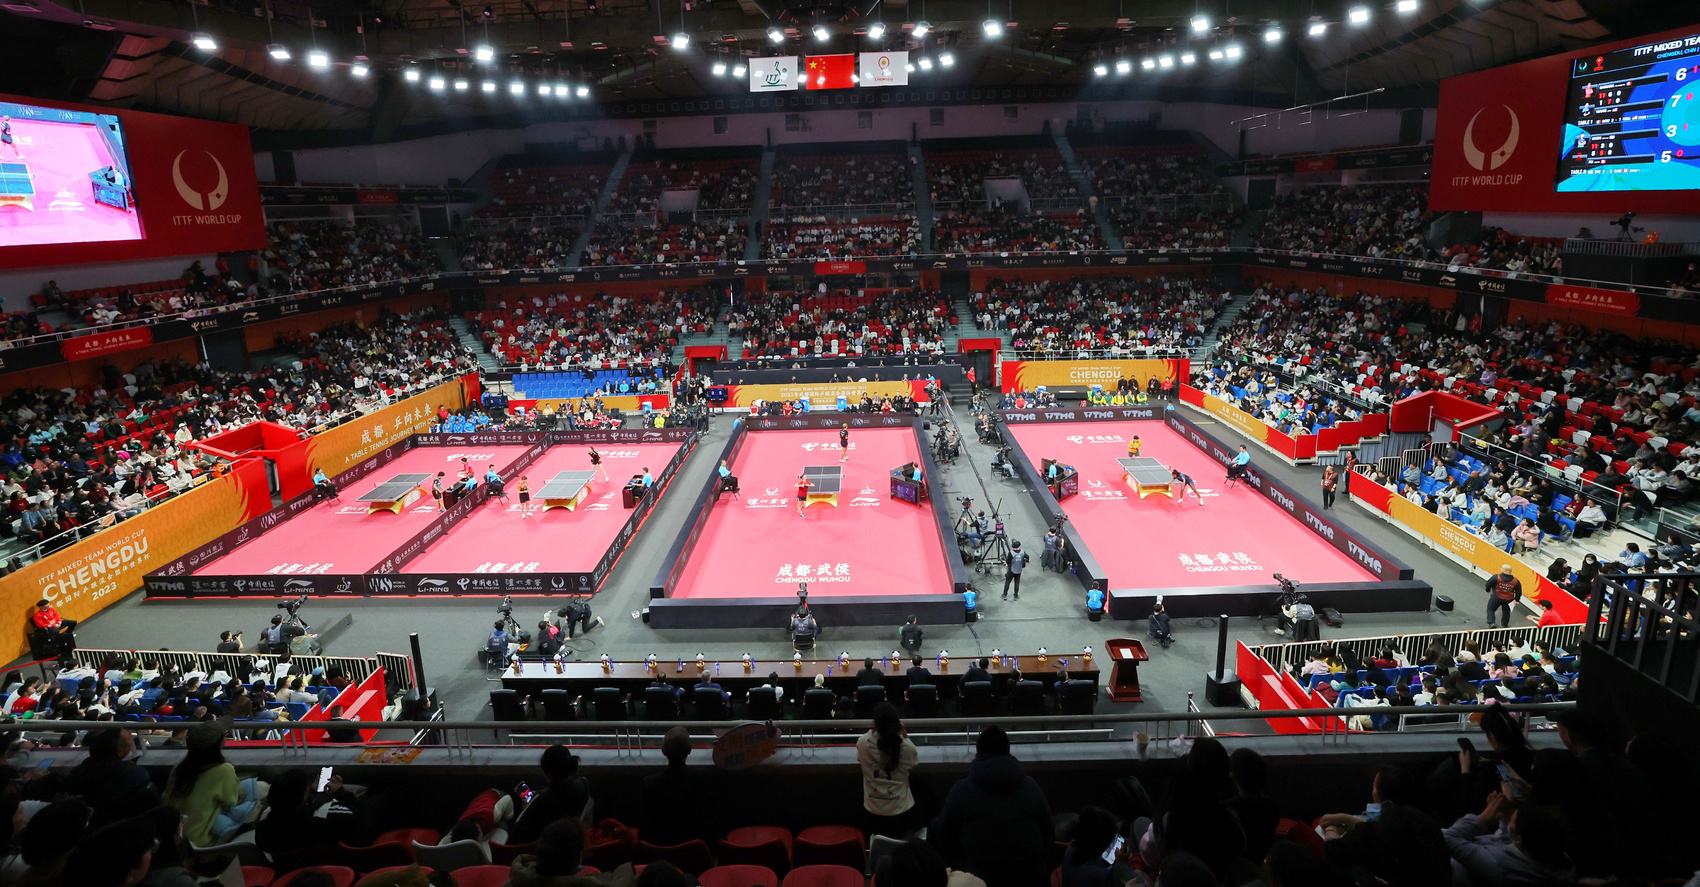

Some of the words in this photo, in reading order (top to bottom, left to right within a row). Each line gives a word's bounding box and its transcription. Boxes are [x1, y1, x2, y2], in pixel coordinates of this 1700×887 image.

[1634, 46, 1653, 56] ITTF
[1653, 40, 1682, 52] MIXED
[1675, 68, 1687, 80] 6
[1671, 94, 1682, 107] 7
[1666, 125, 1678, 137] 3
[1661, 151, 1672, 163] 5
[1452, 176, 1469, 186] ITTF
[1472, 175, 1502, 186] WORLD
[1504, 174, 1523, 185] CUP
[173, 215, 192, 225] ITTF
[195, 215, 226, 224] WORLD
[227, 214, 242, 224] CUP
[1070, 371, 1121, 379] CHENGDU
[1171, 418, 1186, 434] WTMG
[345, 456, 350, 464] A
[351, 448, 368, 460] TABLE
[369, 438, 388, 451] TENNIS
[390, 426, 414, 442] JOURNEY
[414, 420, 427, 430] WITH
[1191, 432, 1207, 449] WTMG
[1270, 486, 1294, 512] WTMG
[1305, 511, 1334, 540] WTMG
[1440, 528, 1476, 551] CHENGDU
[38, 572, 55, 585] ITTF
[57, 559, 83, 576] MIXED
[84, 549, 104, 562] TEAM
[106, 536, 130, 552] WORLD
[131, 528, 145, 539] CUP
[1348, 540, 1382, 574] WTMG
[42, 536, 148, 602] CHENGDU
[56, 553, 150, 607] 都国际乒联混合团体世界杯
[148, 582, 185, 590] WTMG
[92, 582, 117, 600] 2023
